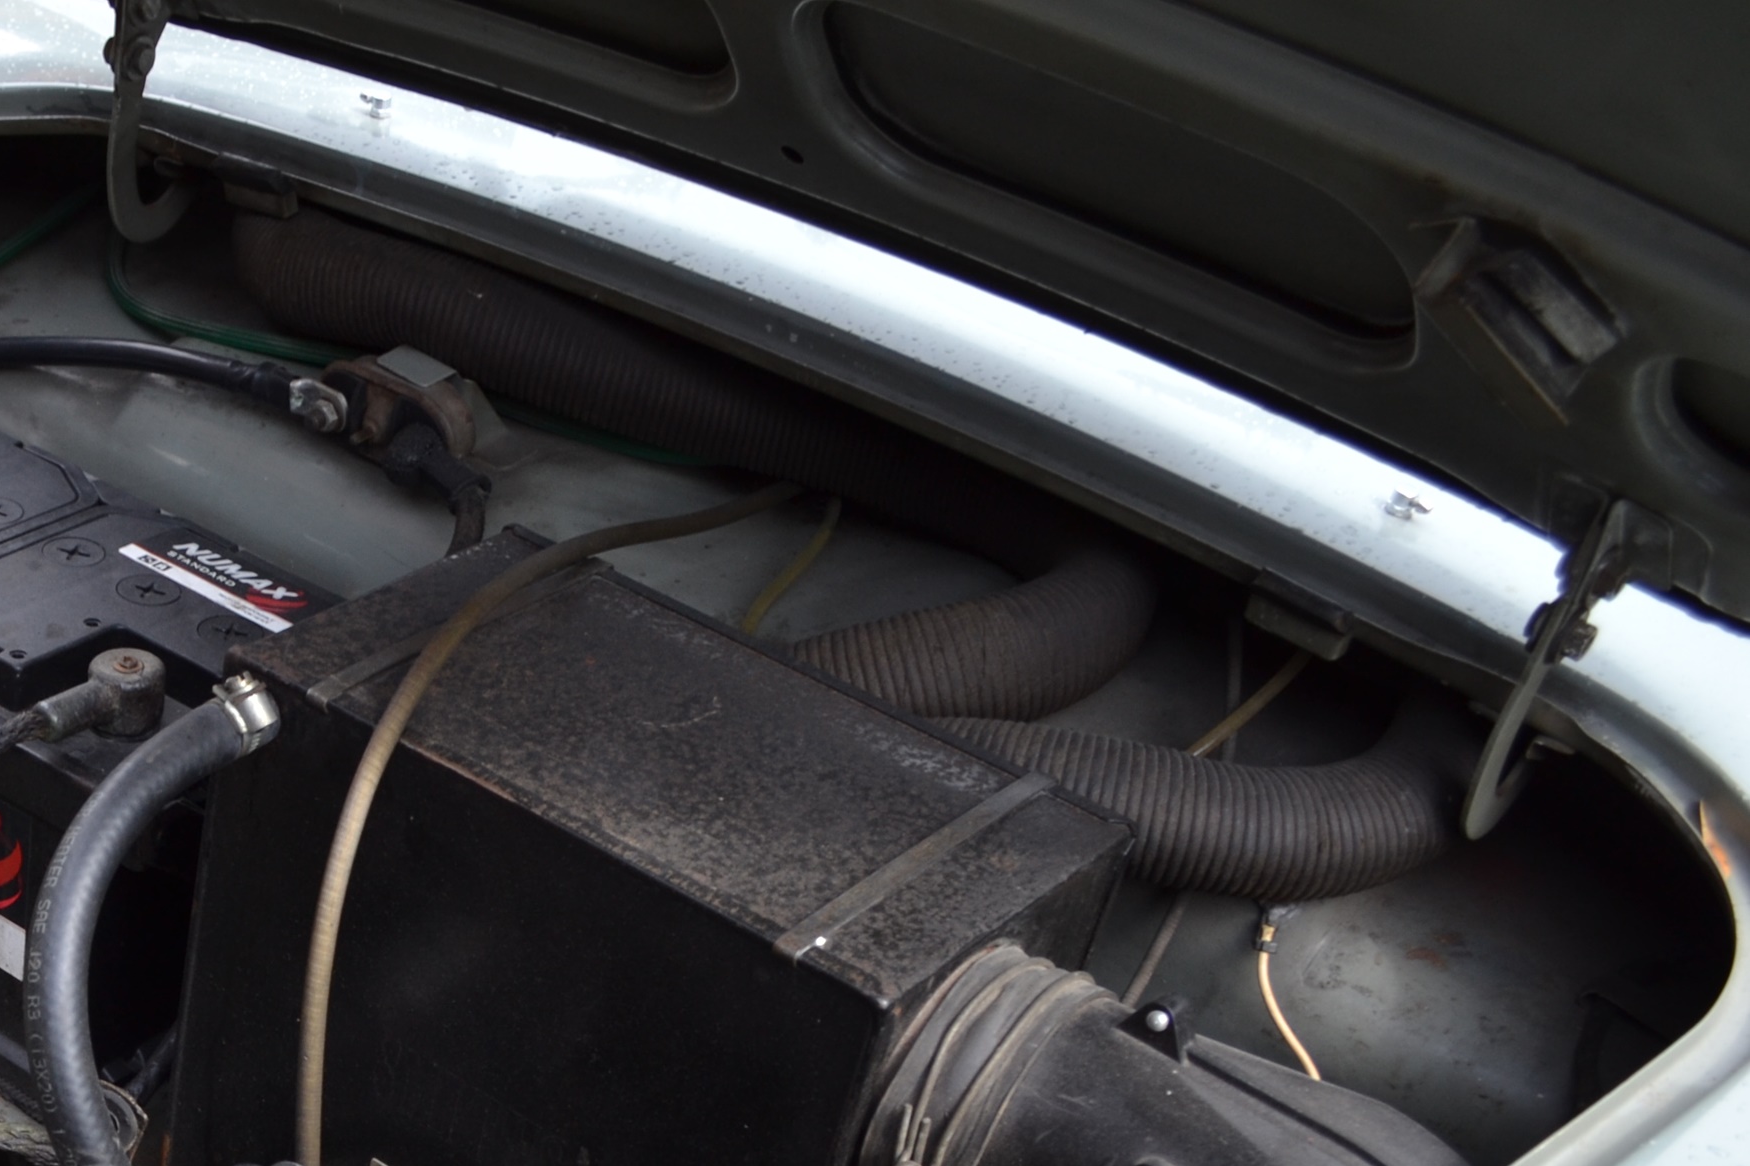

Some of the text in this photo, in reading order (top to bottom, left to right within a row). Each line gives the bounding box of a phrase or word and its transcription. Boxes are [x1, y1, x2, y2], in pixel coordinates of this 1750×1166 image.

[167, 550, 236, 587] STANDARD
[173, 542, 299, 600] NUMAX
[32, 899, 51, 934] SAE
